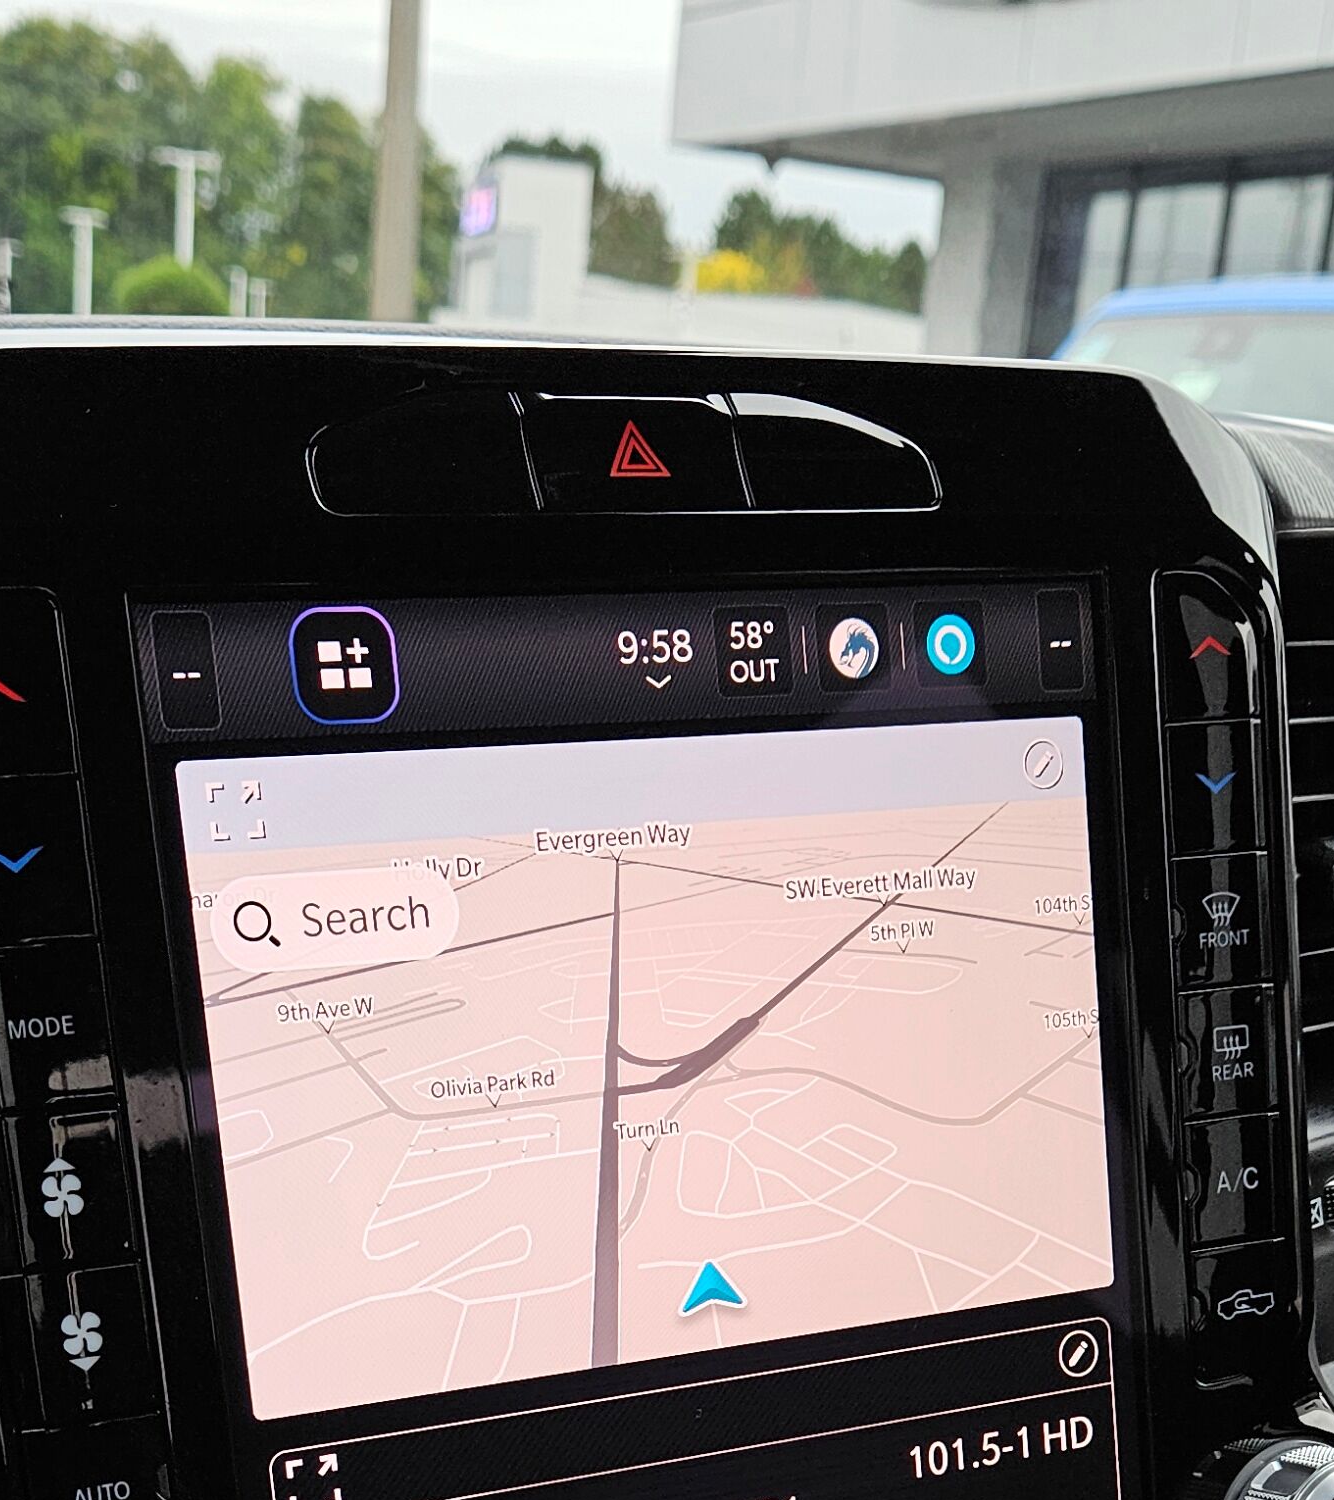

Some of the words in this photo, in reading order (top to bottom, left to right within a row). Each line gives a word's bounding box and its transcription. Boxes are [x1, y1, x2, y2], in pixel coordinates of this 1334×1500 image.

[617, 628, 694, 666] 9:58
[728, 620, 775, 651] 58°
[730, 657, 780, 685] OUT
[536, 827, 643, 854] Evergreen
[646, 824, 691, 850] Way
[456, 857, 482, 879] Dr
[786, 879, 816, 900] SW
[821, 875, 889, 898] Everett
[893, 870, 933, 891] Mall
[938, 868, 976, 890] Way
[301, 896, 431, 937] Search
[1035, 896, 1078, 914] 104th
[870, 924, 897, 942] 5th
[918, 920, 934, 937] W
[1199, 929, 1250, 949] FRONT
[277, 1002, 310, 1022] 9th
[315, 1001, 351, 1019] Ave
[354, 997, 373, 1015] W
[1044, 1010, 1086, 1029] 105th
[7, 1015, 75, 1040] MODE
[1212, 1061, 1254, 1081] REAR
[430, 1080, 483, 1099] Olivia
[487, 1073, 527, 1092] Park
[532, 1070, 555, 1088] Rd
[616, 1121, 656, 1140] Turn
[661, 1119, 680, 1136] Ln
[1217, 1166, 1259, 1194] A/C
[909, 1431, 1031, 1479] 101.5-1
[1042, 1415, 1094, 1454] HD
